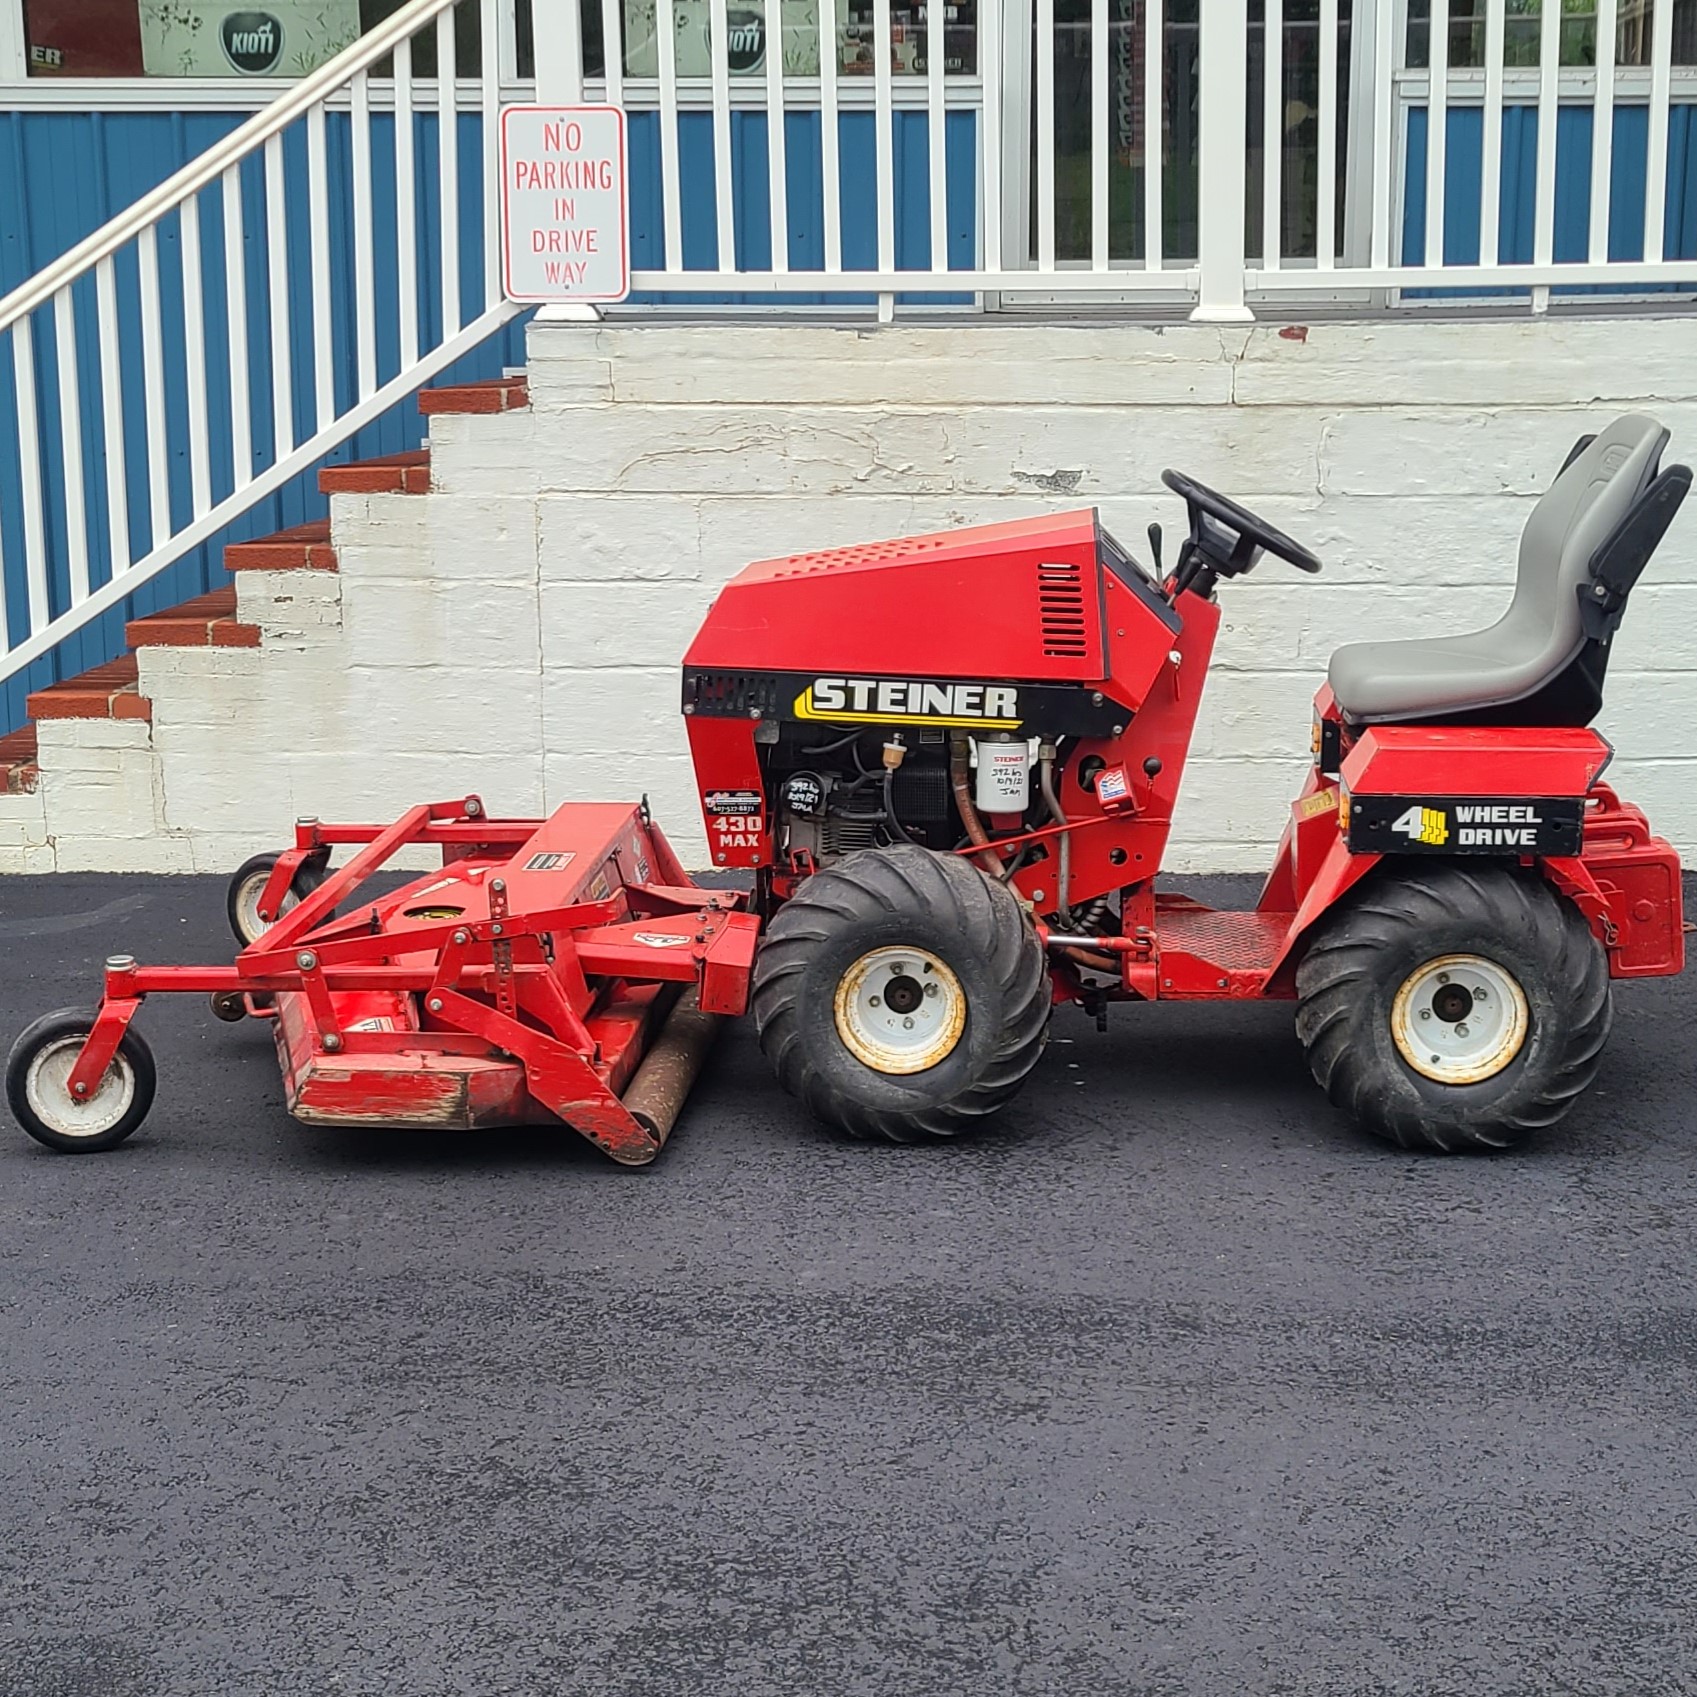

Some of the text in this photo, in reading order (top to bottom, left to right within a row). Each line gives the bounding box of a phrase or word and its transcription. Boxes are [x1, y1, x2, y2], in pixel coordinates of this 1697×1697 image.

[231, 32, 274, 54] KIOTI
[728, 30, 760, 52] IOTI
[544, 122, 581, 152] NO
[516, 160, 612, 190] PARKING
[554, 198, 575, 221] IN
[533, 229, 598, 253] DRIVE
[545, 261, 587, 284] WAY
[813, 678, 1018, 718] STEINER
[712, 816, 762, 832] 430
[1391, 806, 1543, 839] 4 WHEEL
[720, 833, 760, 848] MAX
[1458, 828, 1538, 845] DRIVE
